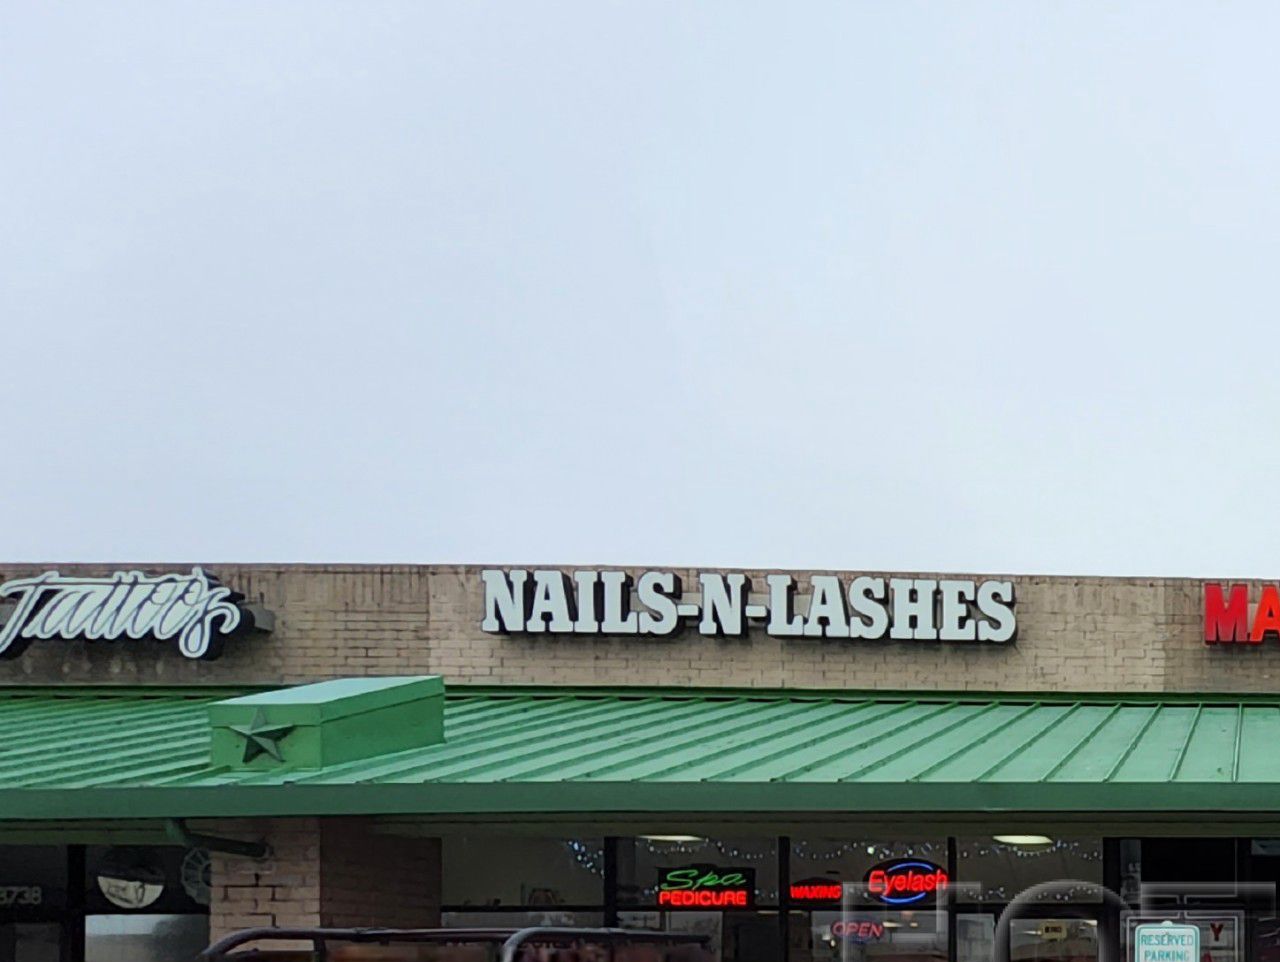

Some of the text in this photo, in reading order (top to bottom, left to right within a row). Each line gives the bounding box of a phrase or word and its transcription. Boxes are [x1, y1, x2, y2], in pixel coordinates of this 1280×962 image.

[481, 569, 1017, 643] NAILS-N-LASHES
[660, 869, 747, 891] Spa
[869, 869, 949, 897] Eyelash
[659, 890, 748, 906] PEDICURE
[790, 885, 842, 899] WAXING
[831, 920, 884, 938] OPEN
[1140, 933, 1194, 947] RESERVED
[1143, 950, 1190, 962] PARKING
